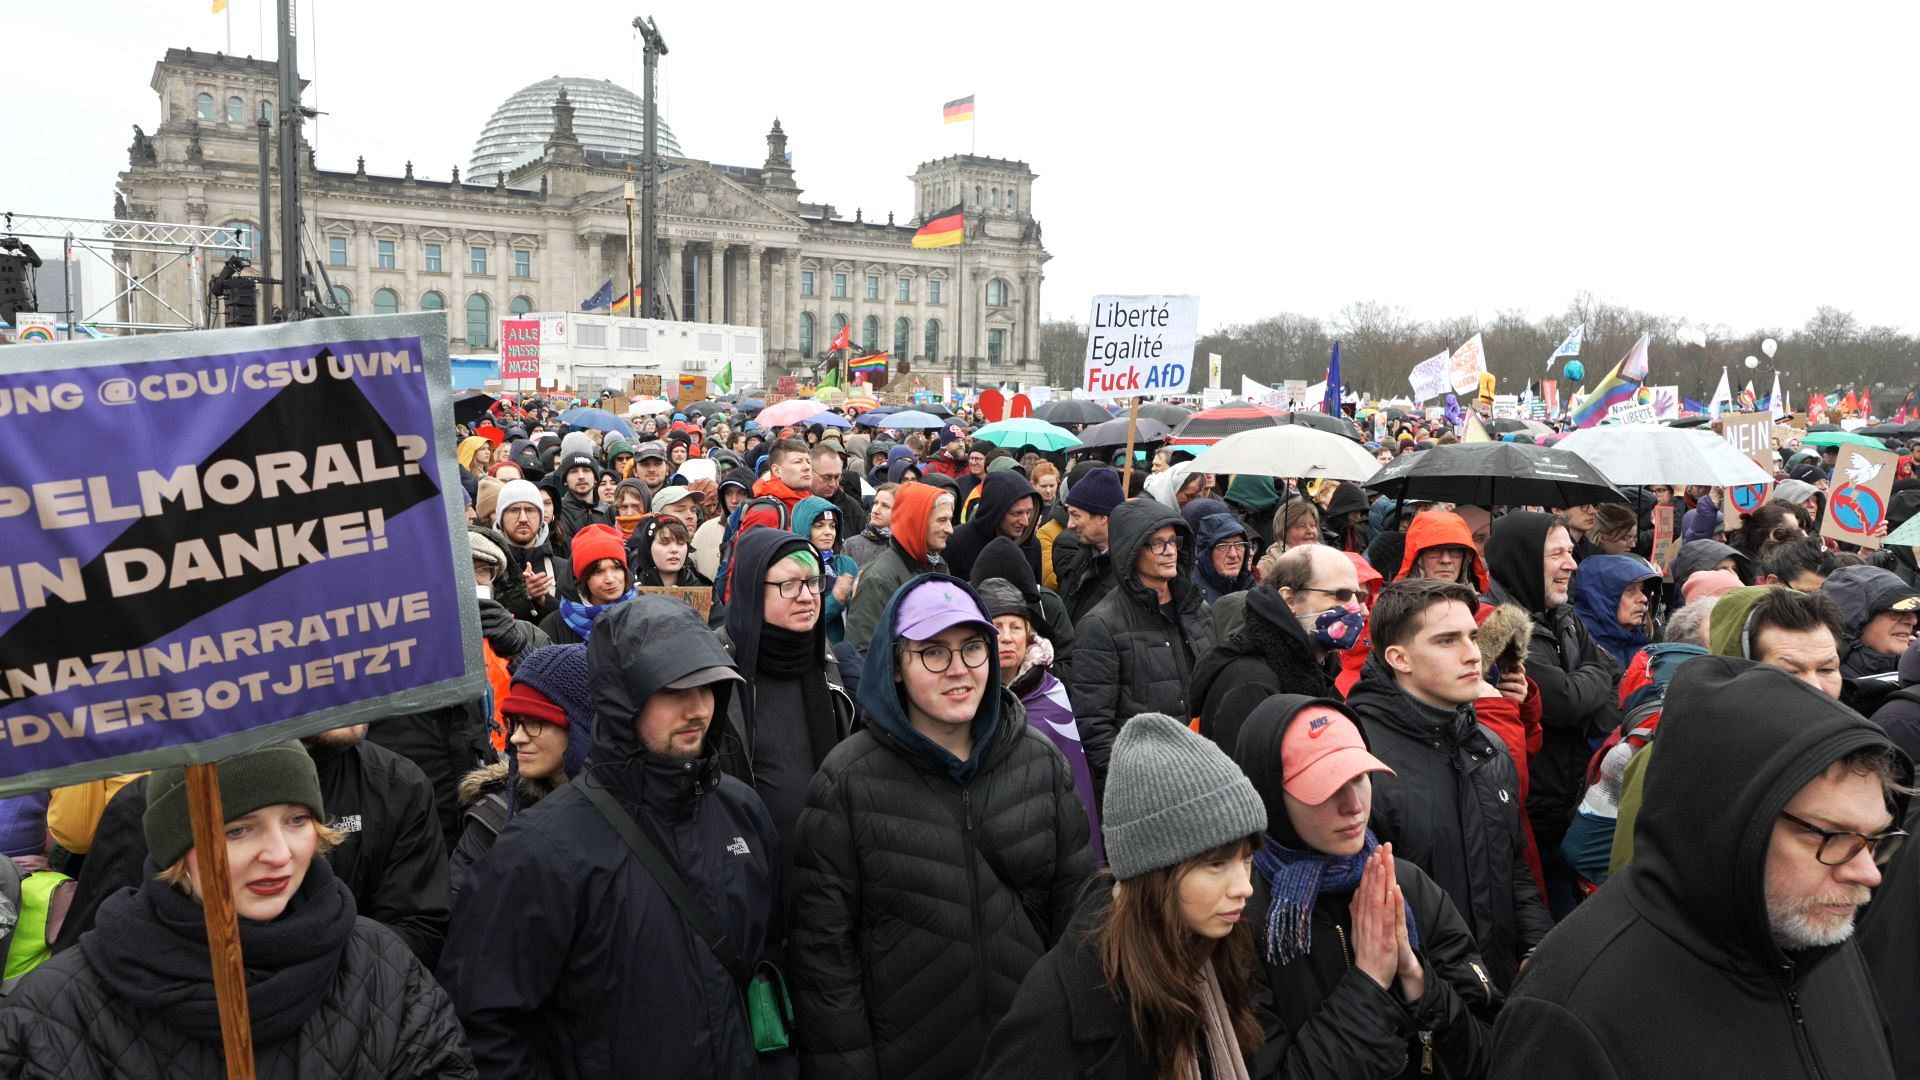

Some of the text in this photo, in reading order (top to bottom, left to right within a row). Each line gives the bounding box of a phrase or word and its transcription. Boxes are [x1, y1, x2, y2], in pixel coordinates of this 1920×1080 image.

[1095, 302, 1169, 328] Liberté
[508, 328, 538, 341] ALLE
[1091, 333, 1163, 366] Egalité
[98, 357, 318, 406] @CDU/CSU
[327, 350, 422, 380] UVM.
[508, 359, 538, 373] NAZIS
[1087, 363, 1185, 393] Fuck AfD
[0, 434, 428, 530] PELMORAL?
[104, 507, 389, 598] DANKE!
[0, 591, 431, 699] NAZINARRATIVE
[0, 638, 418, 748] DVERBOTJETZT
[1309, 716, 1329, 730] NIKE
